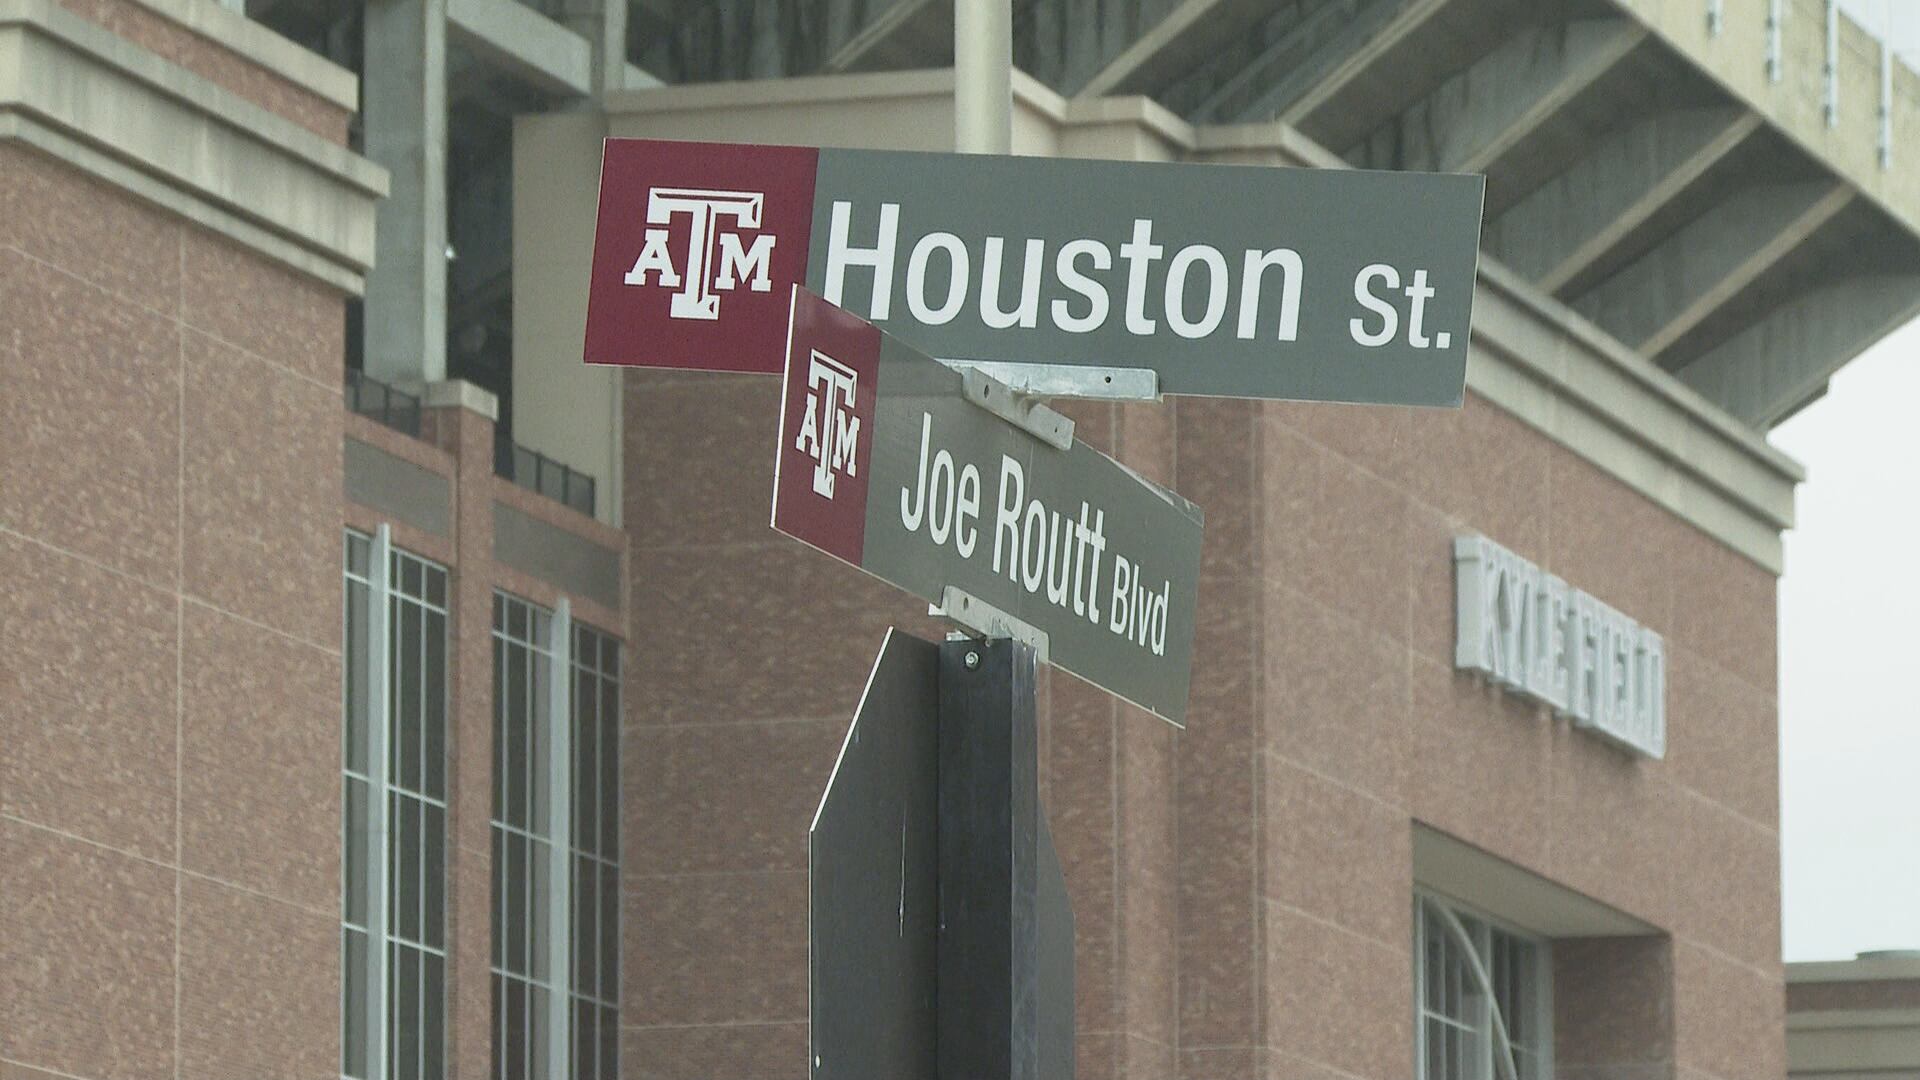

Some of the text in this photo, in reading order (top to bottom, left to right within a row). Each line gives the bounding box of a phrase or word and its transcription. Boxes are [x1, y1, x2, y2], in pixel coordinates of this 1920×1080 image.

[824, 201, 1451, 349] Houston St.
[900, 412, 1170, 657] Joe Routt Blvd
[1456, 535, 1667, 760] KYLE FIELD
